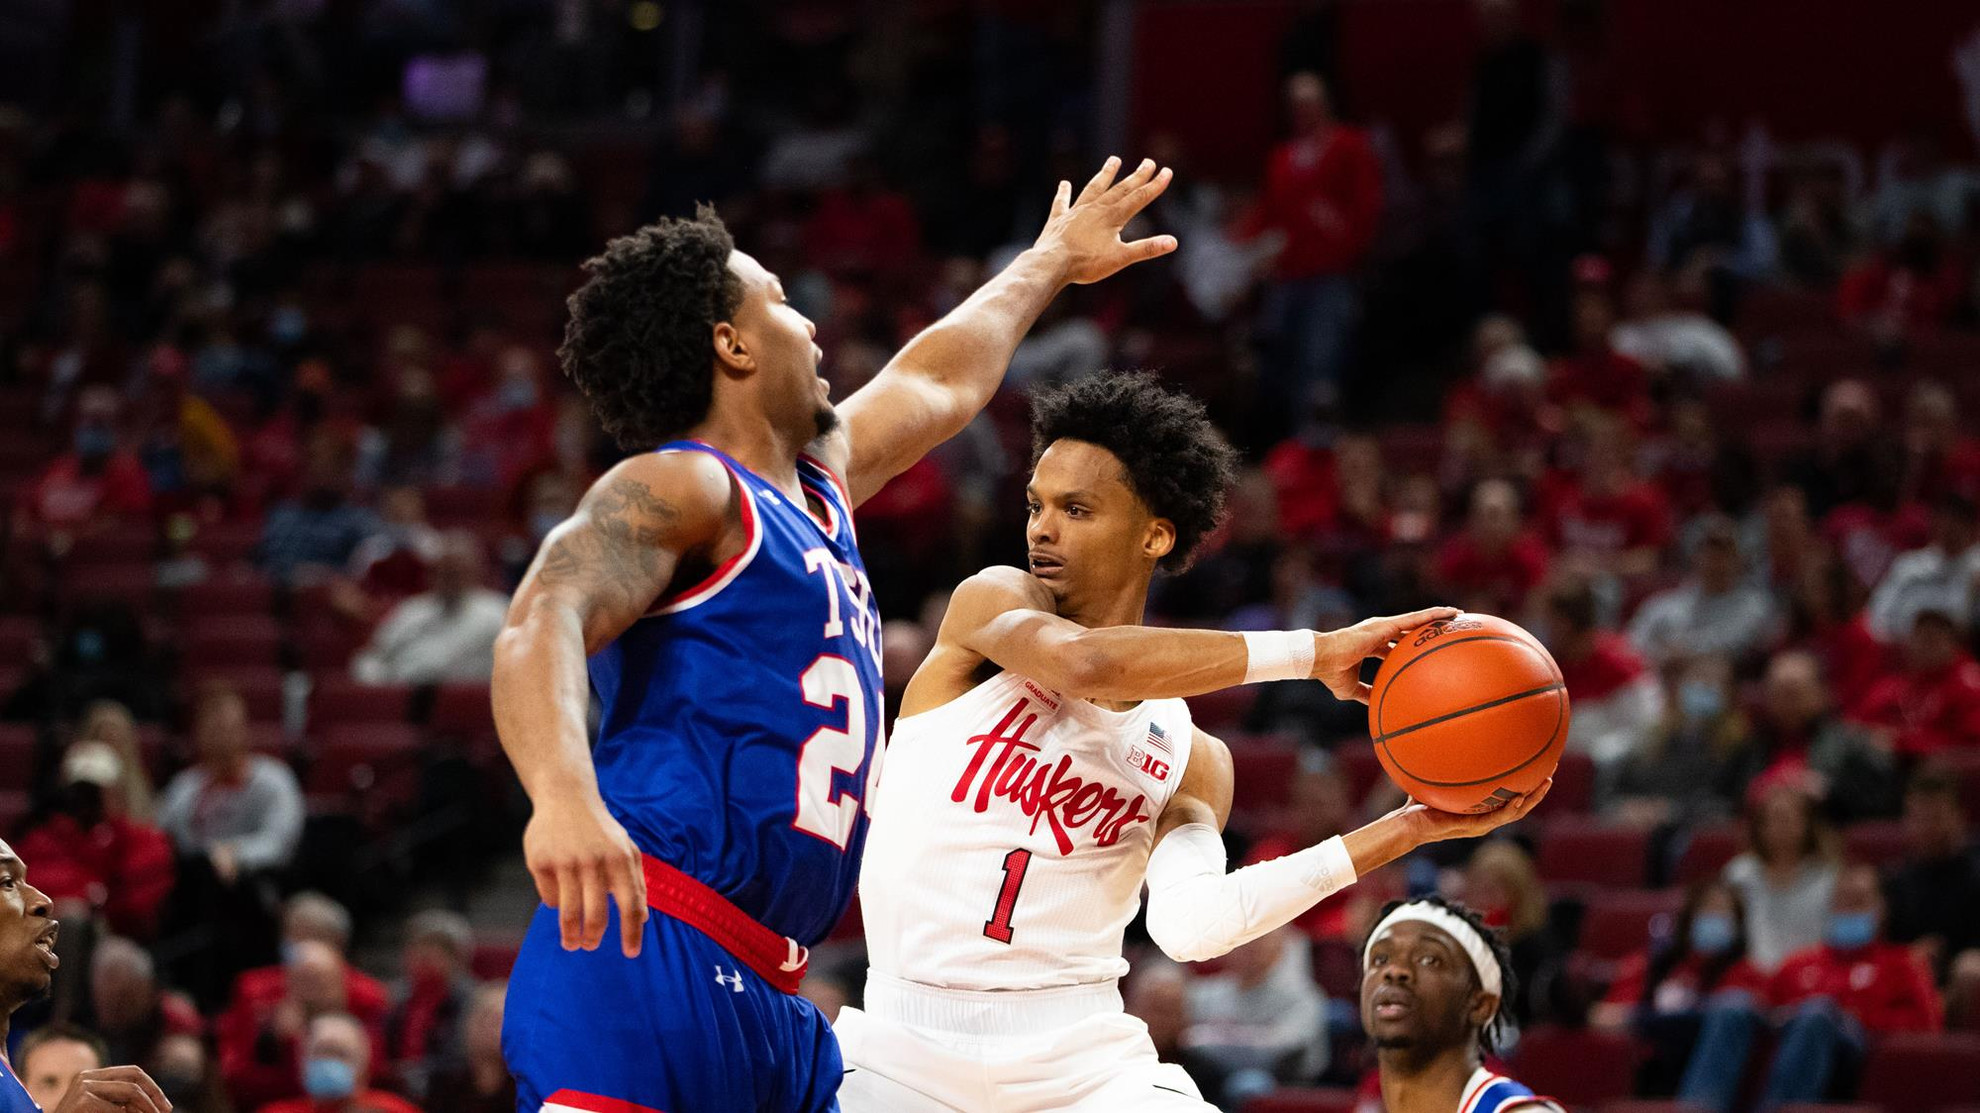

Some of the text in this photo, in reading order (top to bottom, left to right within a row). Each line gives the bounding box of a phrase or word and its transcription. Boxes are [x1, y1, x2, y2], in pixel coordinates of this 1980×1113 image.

[1025, 681, 1059, 710] GRADUATE
[951, 697, 1149, 856] Huskers
[983, 847, 1032, 945] 1
